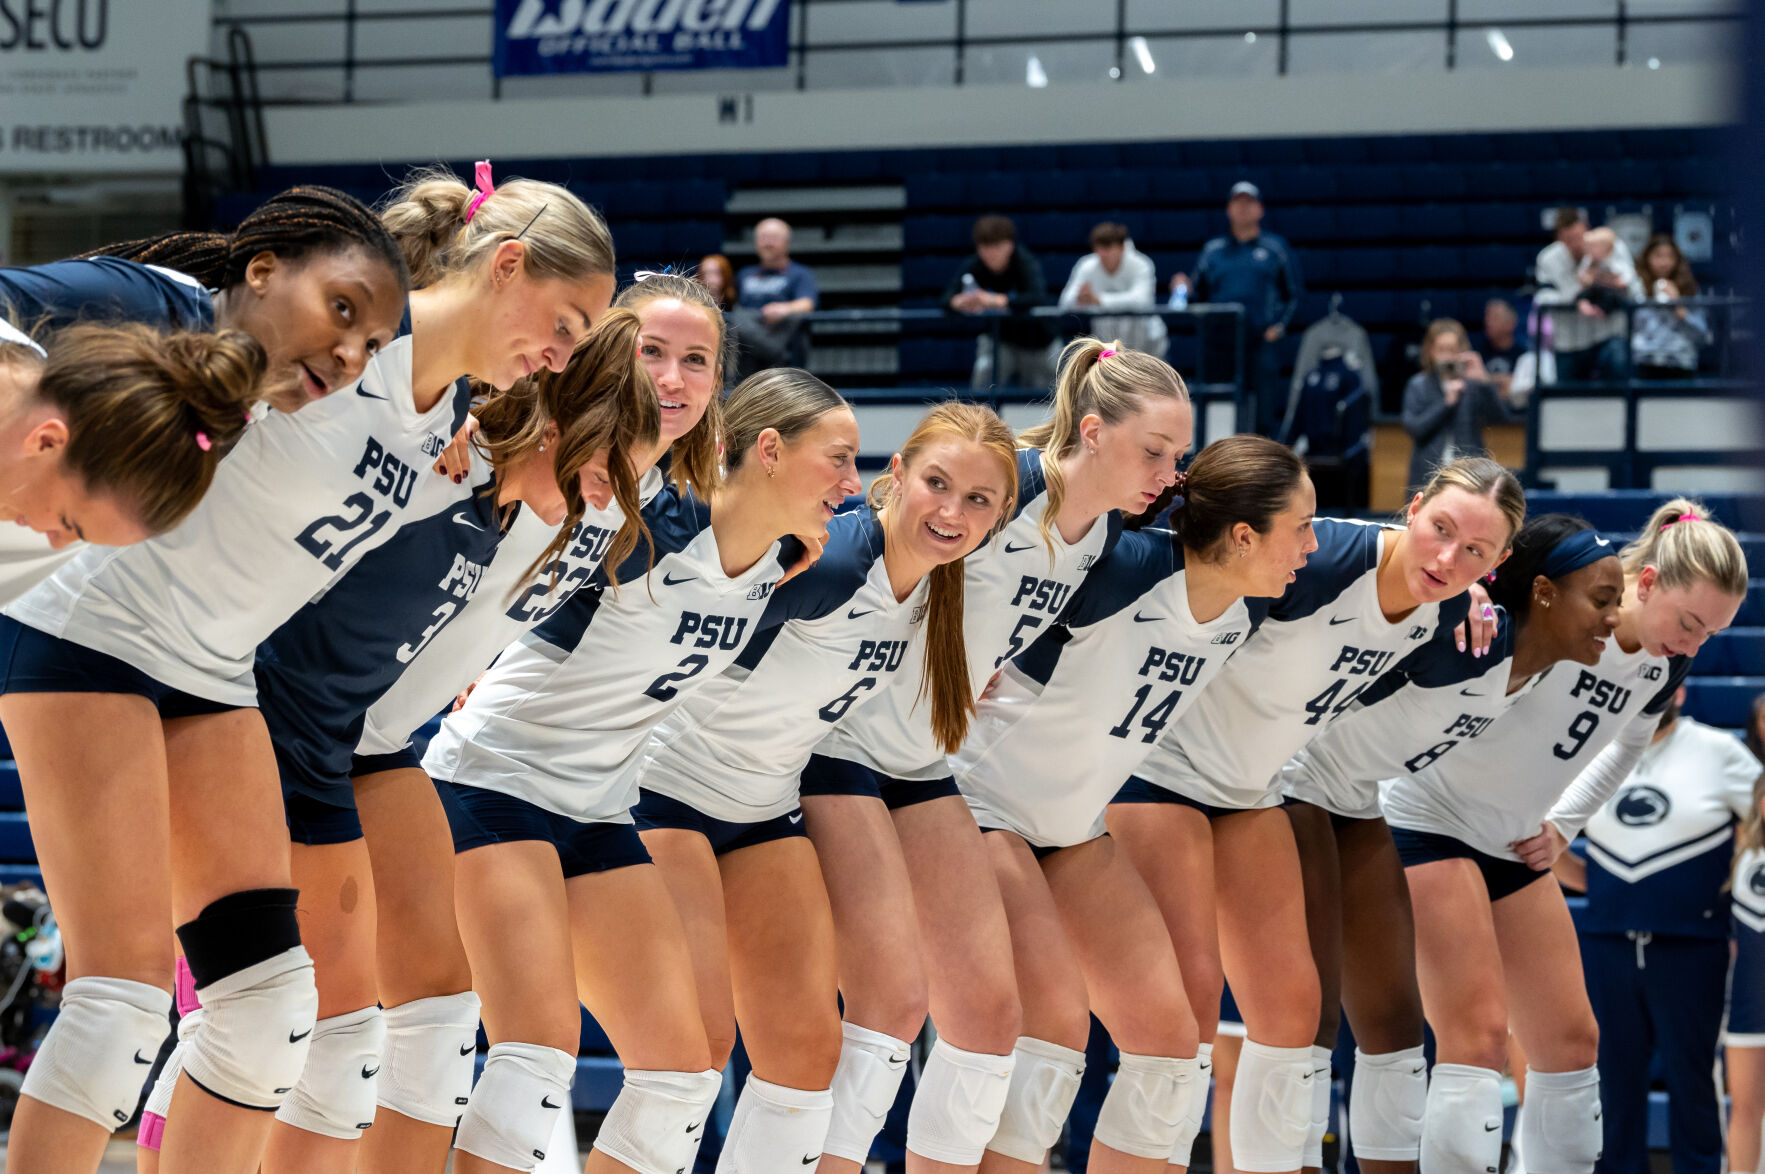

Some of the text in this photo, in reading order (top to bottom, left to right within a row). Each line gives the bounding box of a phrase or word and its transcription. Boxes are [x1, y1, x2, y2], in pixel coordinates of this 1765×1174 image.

[672, 29, 747, 51] BALL
[352, 435, 419, 510] PSU
[293, 491, 393, 572] 21
[505, 559, 592, 622] 23
[1010, 574, 1072, 615] PSU
[396, 601, 457, 664] 3
[670, 610, 748, 651] PSU
[994, 613, 1043, 670] 5
[643, 653, 709, 702] 2
[848, 640, 909, 672] PSU
[1137, 645, 1207, 686] PSU
[1329, 645, 1396, 677] PSU
[818, 677, 877, 723] 6
[1109, 683, 1183, 744] 14
[1303, 678, 1370, 726] 44
[1569, 668, 1632, 715] PSU
[1443, 713, 1495, 739] PSU
[1552, 710, 1600, 762] 9
[1404, 740, 1460, 774] 8
